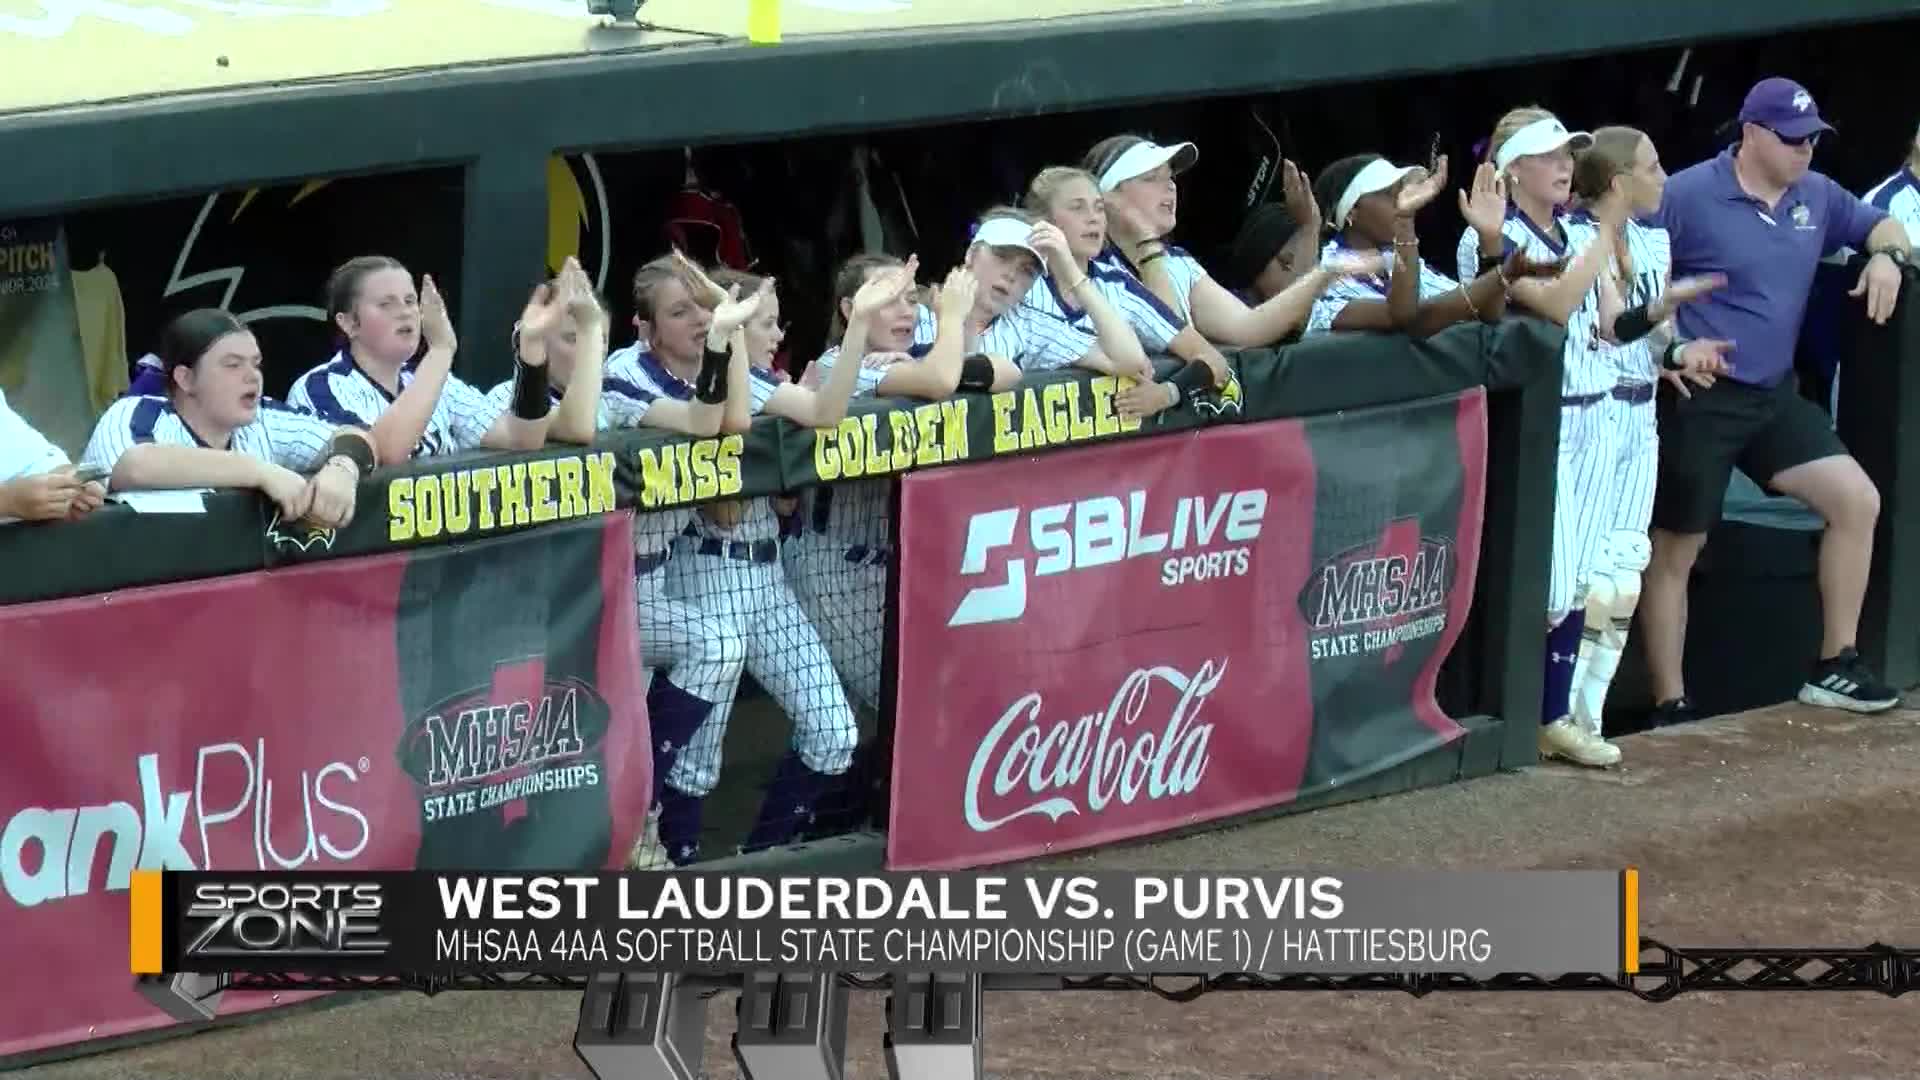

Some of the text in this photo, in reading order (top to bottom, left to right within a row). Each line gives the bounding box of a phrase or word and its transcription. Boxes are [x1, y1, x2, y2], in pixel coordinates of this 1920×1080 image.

[388, 452, 616, 542] SOUTHERN
[638, 434, 744, 508] MISS
[814, 399, 970, 481] GOLDEN
[1160, 547, 1250, 586] SPORTS
[1314, 545, 1447, 629] MHSAA
[1311, 634, 1360, 660] STATE
[426, 688, 583, 786] MHSAA
[424, 763, 600, 821] STATE CHAMPIONSHIPS
